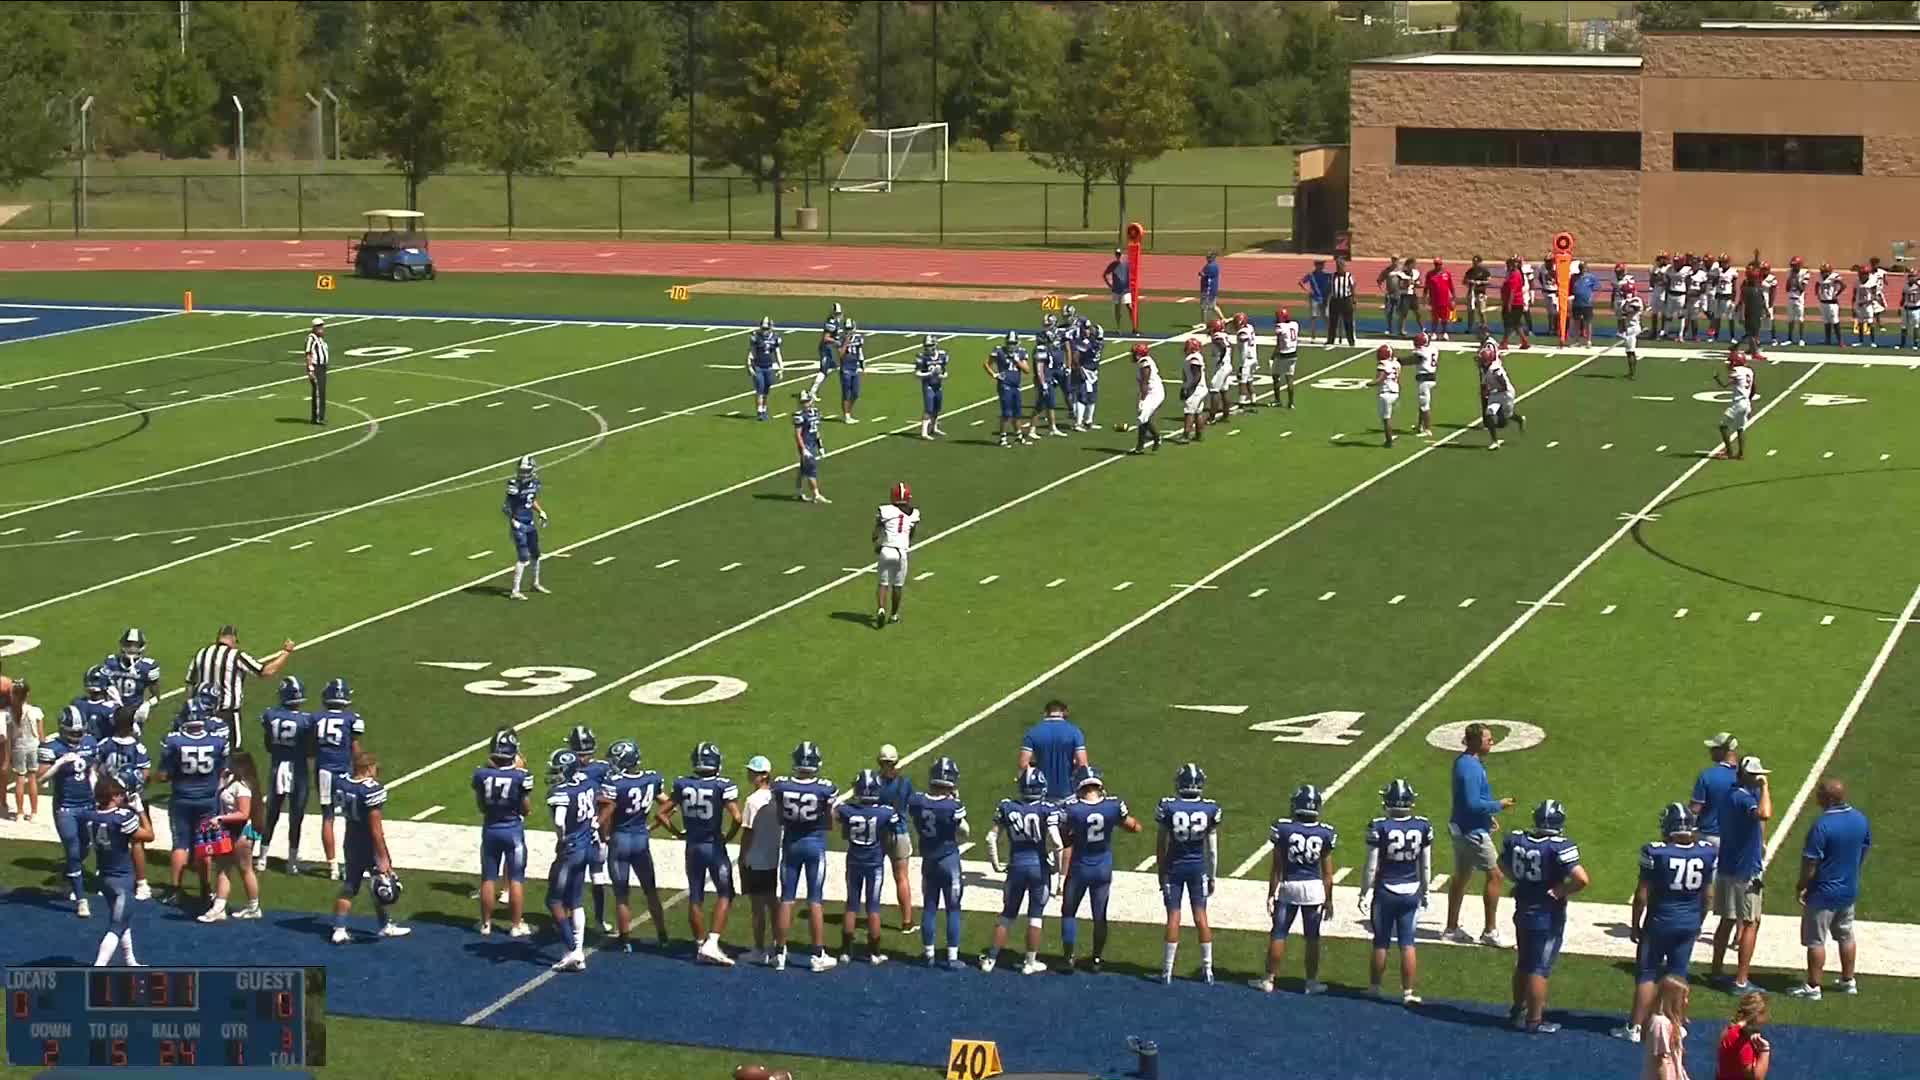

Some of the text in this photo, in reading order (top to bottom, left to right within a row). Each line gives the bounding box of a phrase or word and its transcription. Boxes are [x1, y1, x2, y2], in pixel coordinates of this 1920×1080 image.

[319, 276, 330, 288] G
[673, 286, 686, 299] 10
[1043, 295, 1056, 310] 20
[270, 718, 298, 747] 12
[315, 717, 345, 747] 15
[180, 745, 215, 775] 55
[483, 776, 513, 800] 17
[624, 783, 656, 815] 34
[682, 786, 714, 820] 25
[783, 791, 818, 821] 52
[848, 815, 878, 844] 21
[1086, 812, 1105, 843] 2
[1172, 811, 1208, 842] 82
[1387, 829, 1423, 862] 23
[1510, 845, 1542, 881] 63
[1668, 857, 1705, 891] 76
[950, 1043, 987, 1080] 40
